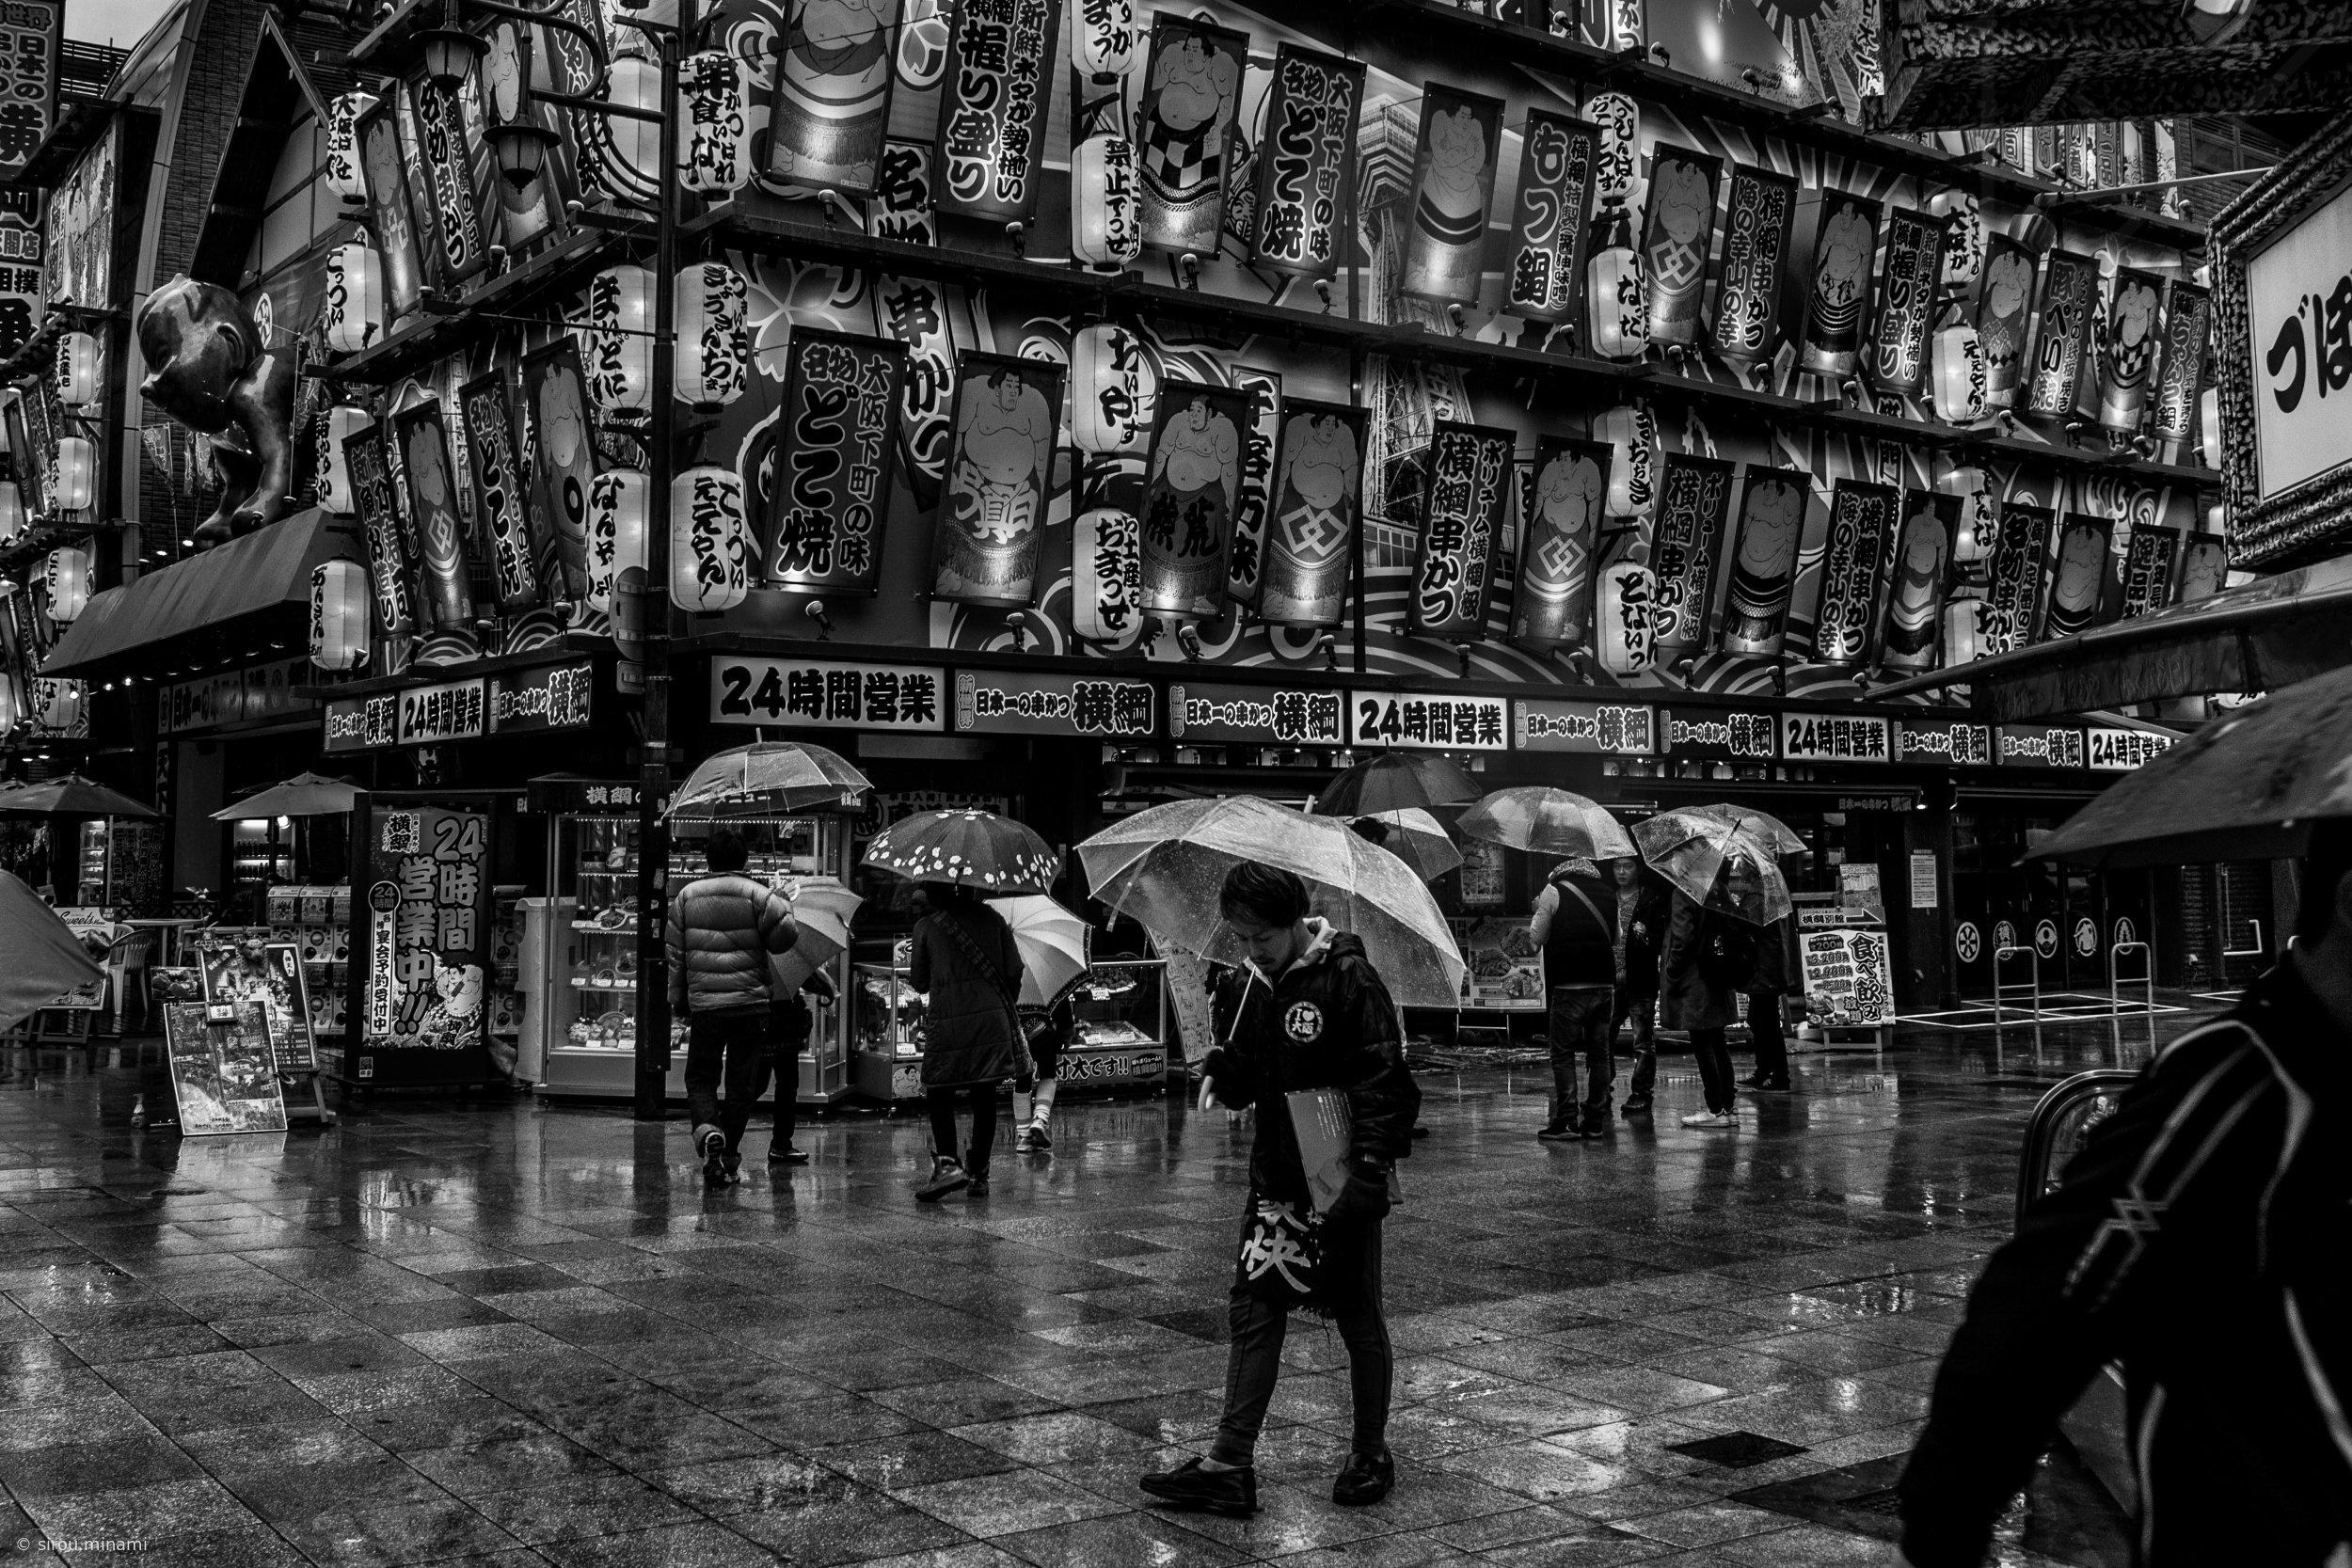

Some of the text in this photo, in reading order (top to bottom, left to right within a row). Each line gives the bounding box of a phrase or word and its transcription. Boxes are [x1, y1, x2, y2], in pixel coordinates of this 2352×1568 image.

[1510, 122, 1568, 309] もつ鍋
[1743, 185, 1786, 350] 横綱串かつ
[838, 355, 895, 577] 大阪下町の味
[1419, 432, 1479, 627] 横綱串かつ
[403, 686, 483, 740] 24時間営業
[720, 666, 938, 723] 24時間営業
[1071, 681, 1155, 734] 横綱
[1272, 692, 1342, 740] 横綱
[1359, 698, 1502, 746] 24時間営業
[1596, 706, 1651, 752] 横綱
[1727, 714, 1775, 757] 横綱
[1788, 719, 1886, 758] 24時間営業
[434, 816, 485, 953] 24時間
[60, 911, 95, 926] Sweets
[1292, 1021, 1314, 1035] 大阪
